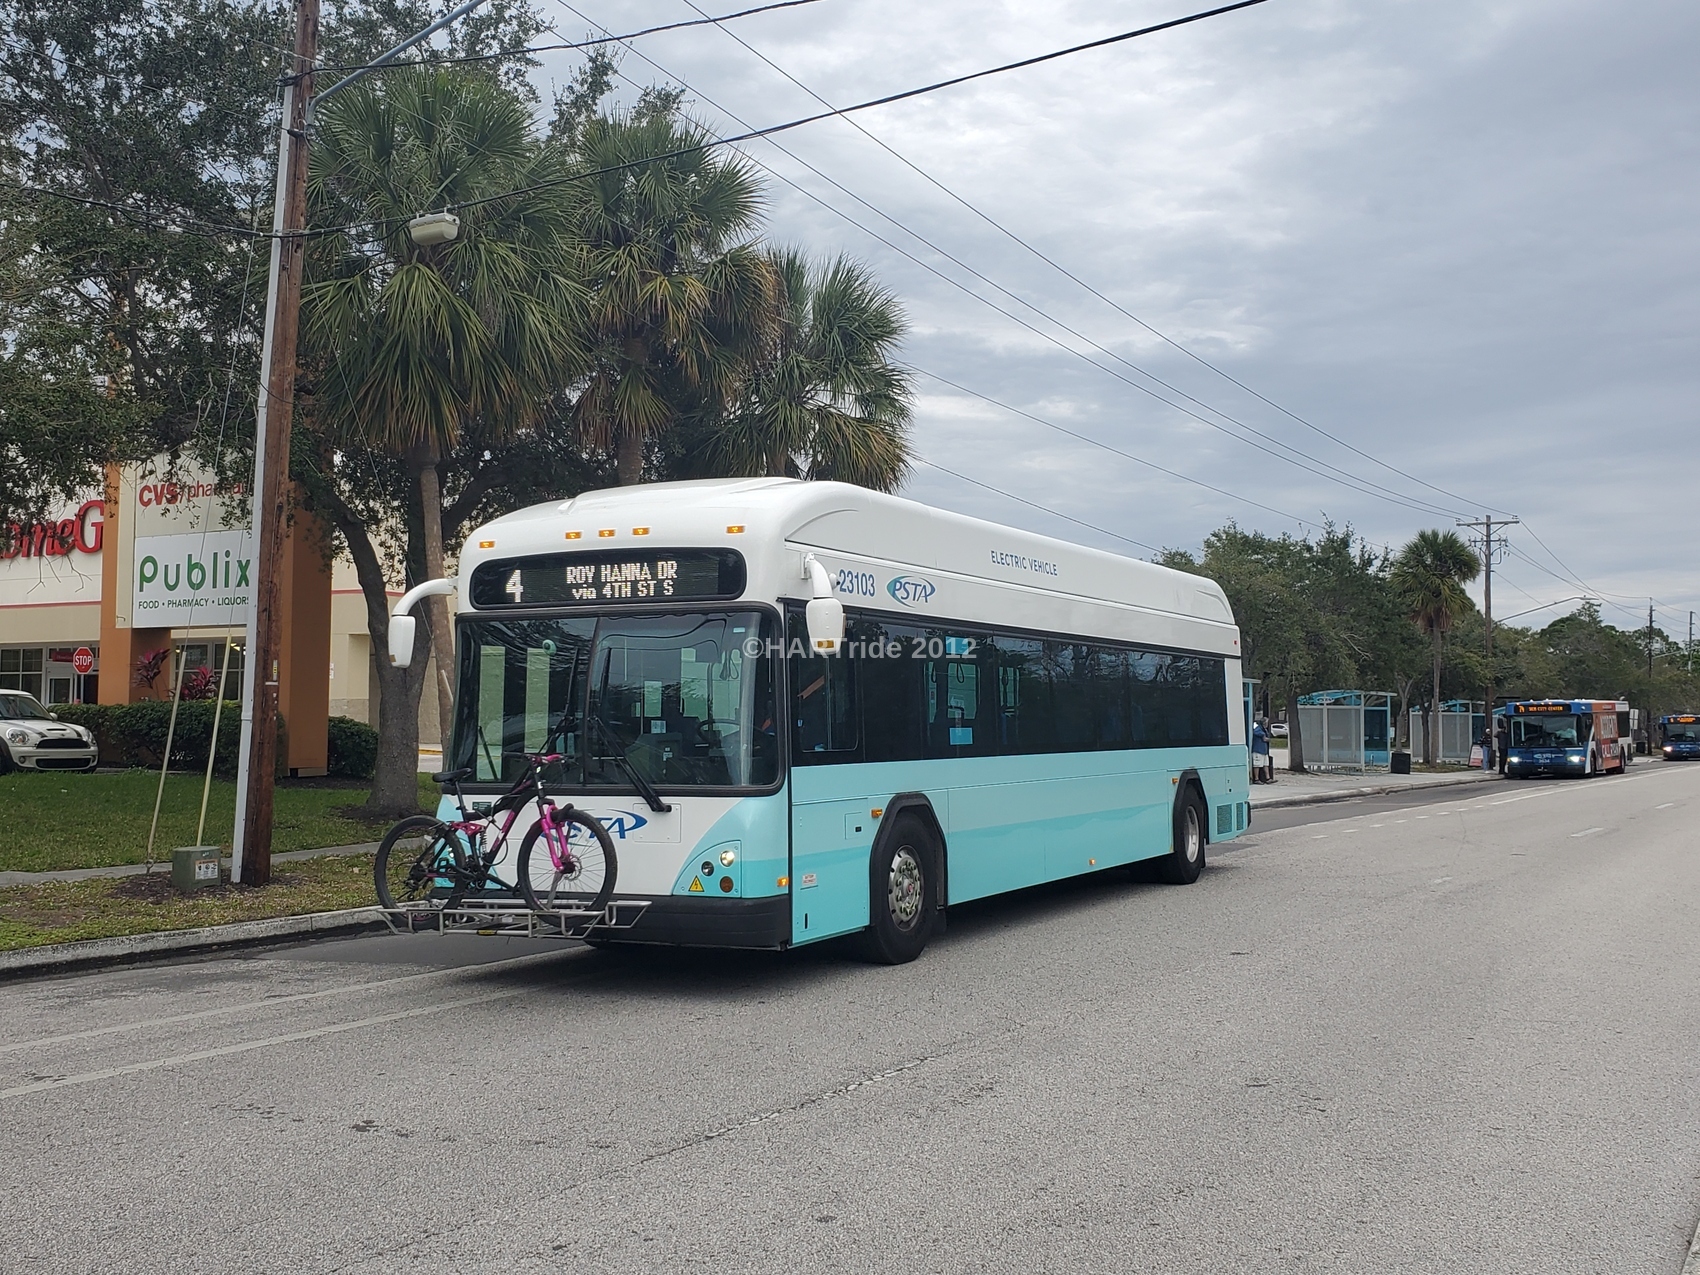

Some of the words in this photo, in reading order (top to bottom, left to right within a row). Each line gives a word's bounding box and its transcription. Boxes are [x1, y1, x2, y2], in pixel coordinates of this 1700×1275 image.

[139, 550, 251, 592] Publix
[566, 565, 595, 584] ROY
[657, 560, 678, 579] DR
[990, 550, 1027, 570] ELECTRIC
[1028, 558, 1058, 576] VEHICLE
[505, 569, 524, 603] 4
[571, 584, 597, 600] via
[602, 581, 632, 598] 4TH
[637, 580, 657, 597] ST
[663, 579, 674, 596] S
[839, 569, 875, 597] 23103
[138, 600, 160, 609] FOOD
[167, 597, 210, 608] PHARMACY
[75, 655, 92, 666] STOP
